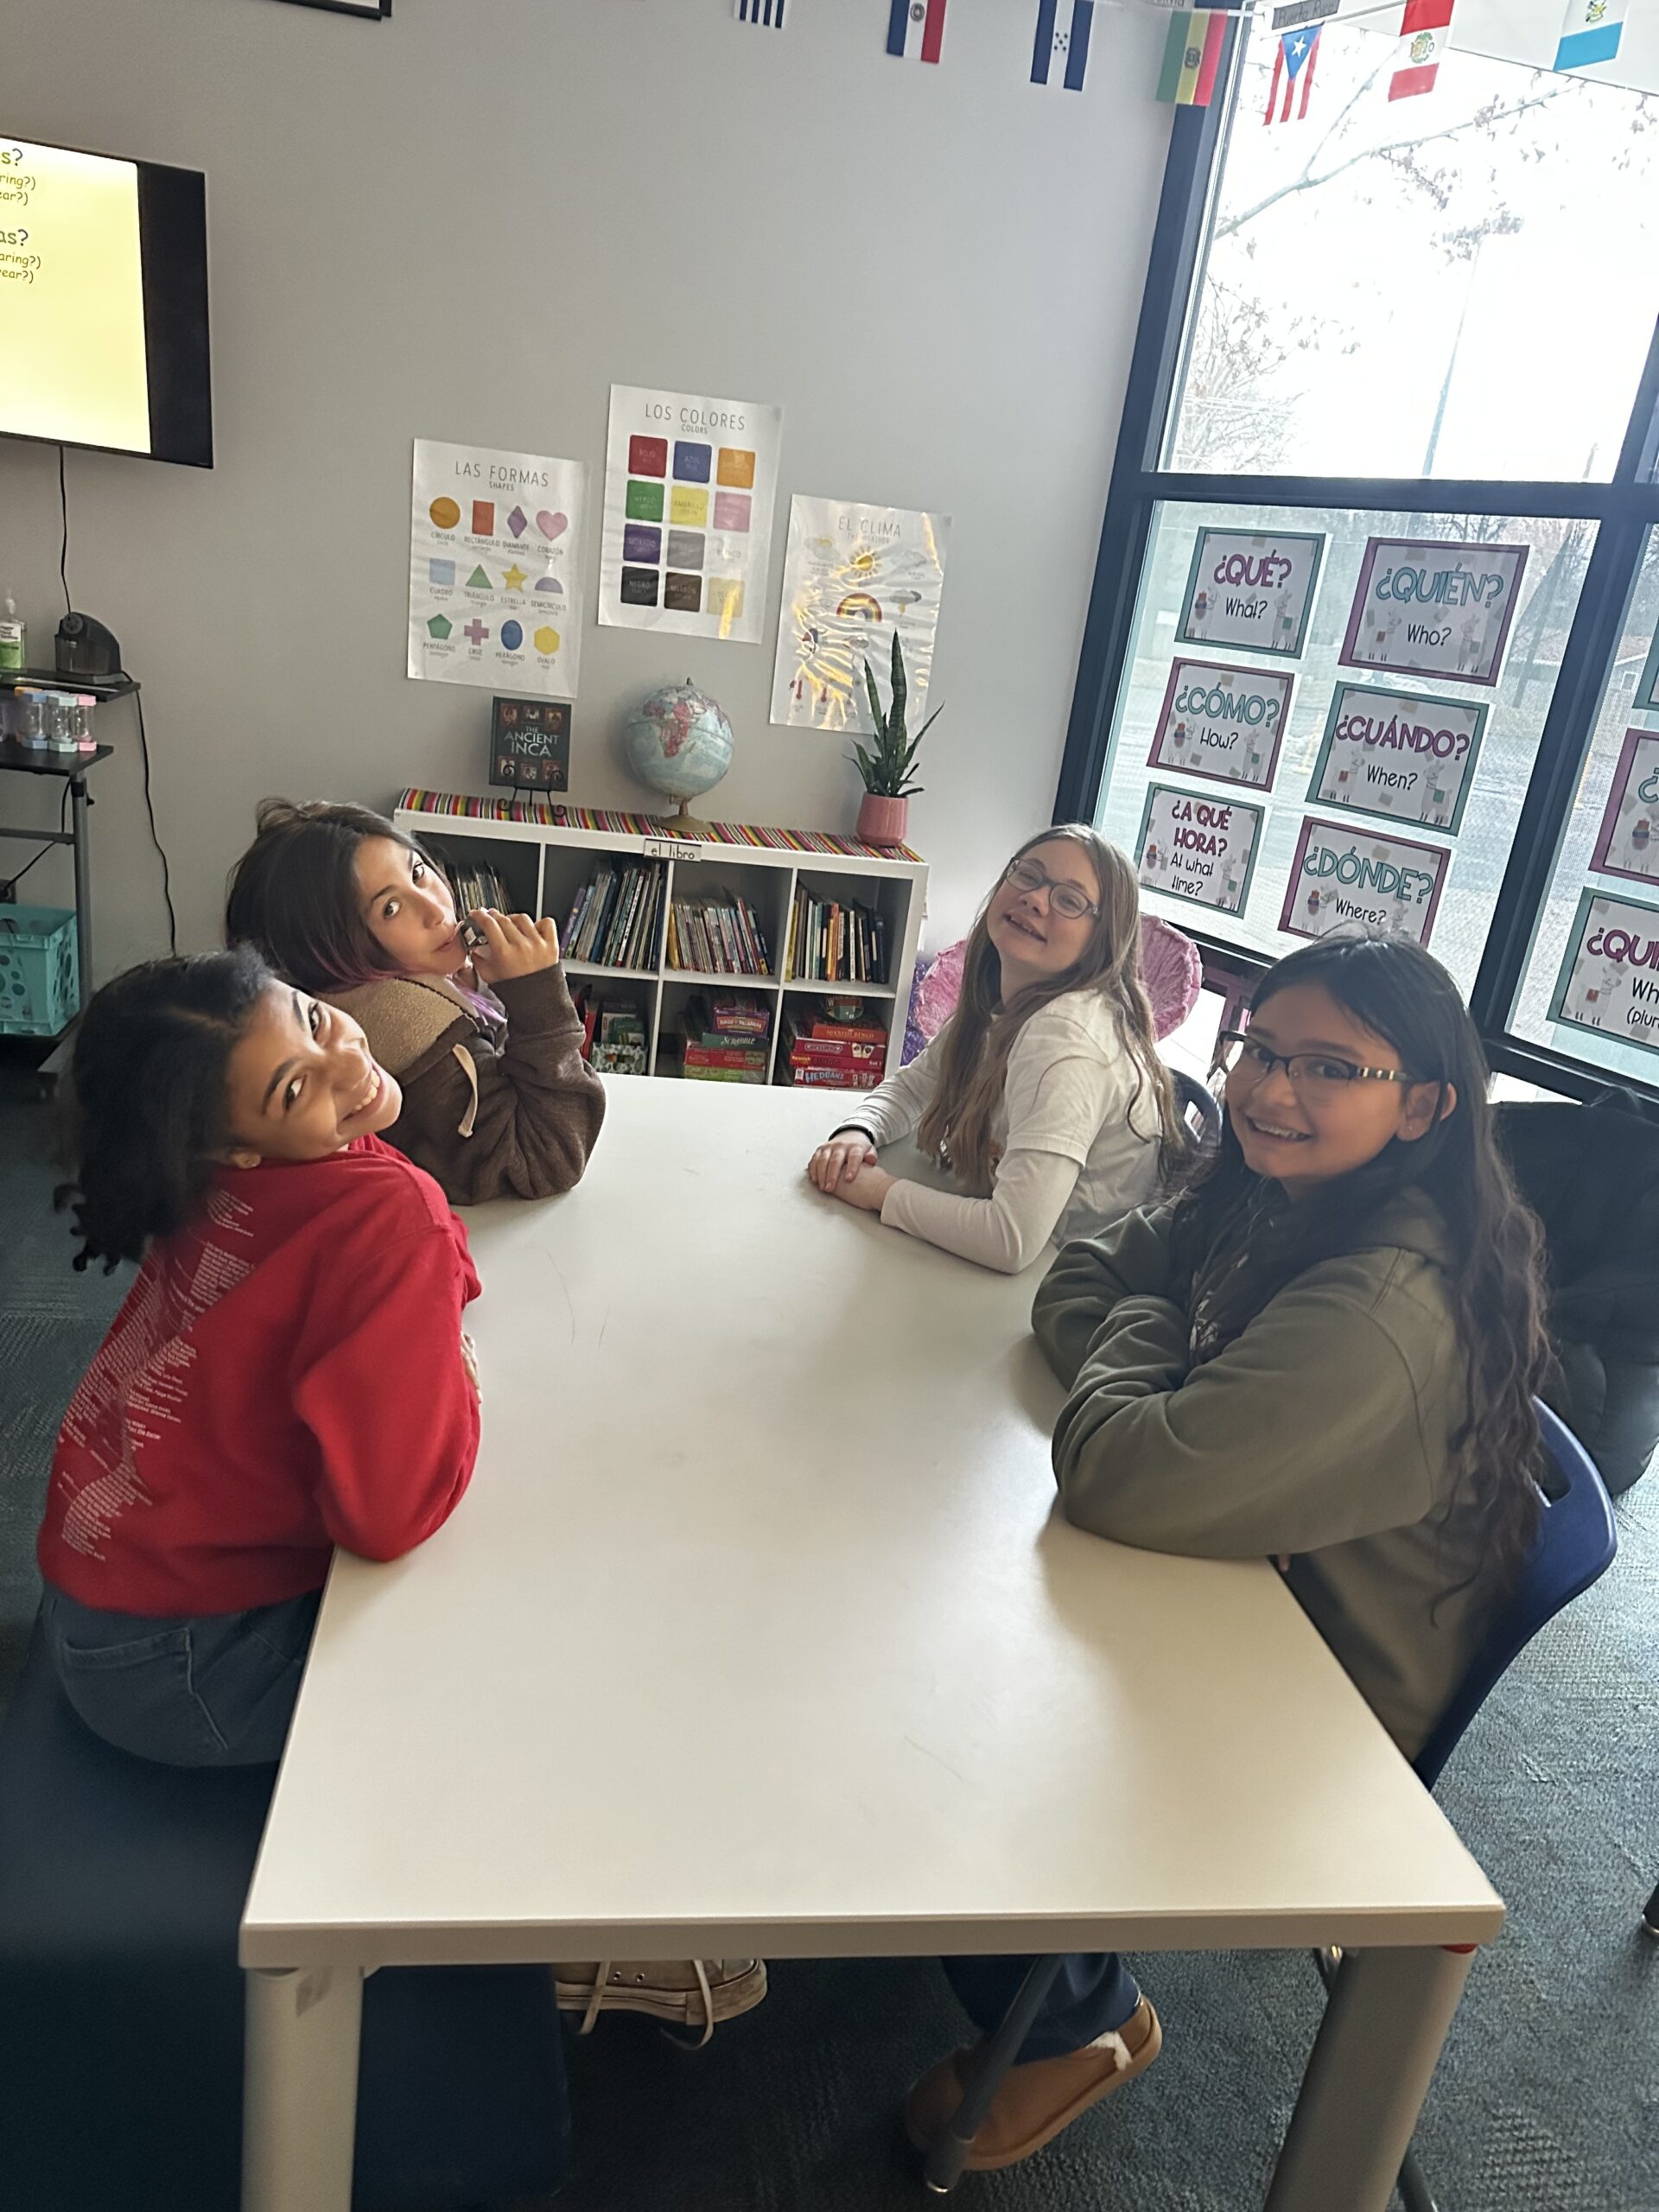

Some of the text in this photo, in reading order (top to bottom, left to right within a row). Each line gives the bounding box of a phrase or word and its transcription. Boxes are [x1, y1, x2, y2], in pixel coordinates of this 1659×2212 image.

[1, 148, 23, 166] s?
[0, 270, 34, 283] ear?)
[645, 404, 746, 430] LOS COLORES
[682, 424, 709, 434] COLORS
[639, 449, 657, 458] ROJO
[455, 461, 549, 487] LAS FORMAS
[488, 481, 515, 491] SHAPES
[674, 500, 705, 511] AMARILLO
[838, 517, 900, 537] EL CLIMA
[464, 535, 500, 548] RECTÁNGULO
[502, 540, 530, 551] DIAMANTE
[1213, 549, 1293, 588] ¿QUÉ?
[429, 587, 453, 596] CUADRO
[1376, 562, 1504, 608] ¿QUIÉN?
[501, 595, 526, 606] ESTRELLA
[1225, 597, 1268, 620] What?
[1407, 623, 1452, 646] Who?
[468, 648, 483, 657] CRUZ
[1175, 682, 1280, 728] ¿CÓMO?
[505, 731, 560, 745] ANCIENT
[1199, 727, 1239, 750] How?
[1335, 714, 1471, 761] ¿CUÁNDO?
[511, 741, 552, 757] INCA
[1367, 764, 1419, 791] When?
[1171, 799, 1232, 830] ¿A QUÉ
[652, 842, 695, 860] el libro
[1173, 827, 1228, 857] HORA?
[1170, 852, 1214, 877] At what
[1303, 846, 1434, 904] ¿DÓNDE?
[1172, 875, 1204, 896] time?
[1335, 898, 1387, 925] Where?
[1586, 927, 1659, 971] ¿QUI
[1626, 1006, 1659, 1028] (plur
[721, 1036, 756, 1046] SCRABBLE
[826, 1029, 874, 1039] SPANISH BINGO
